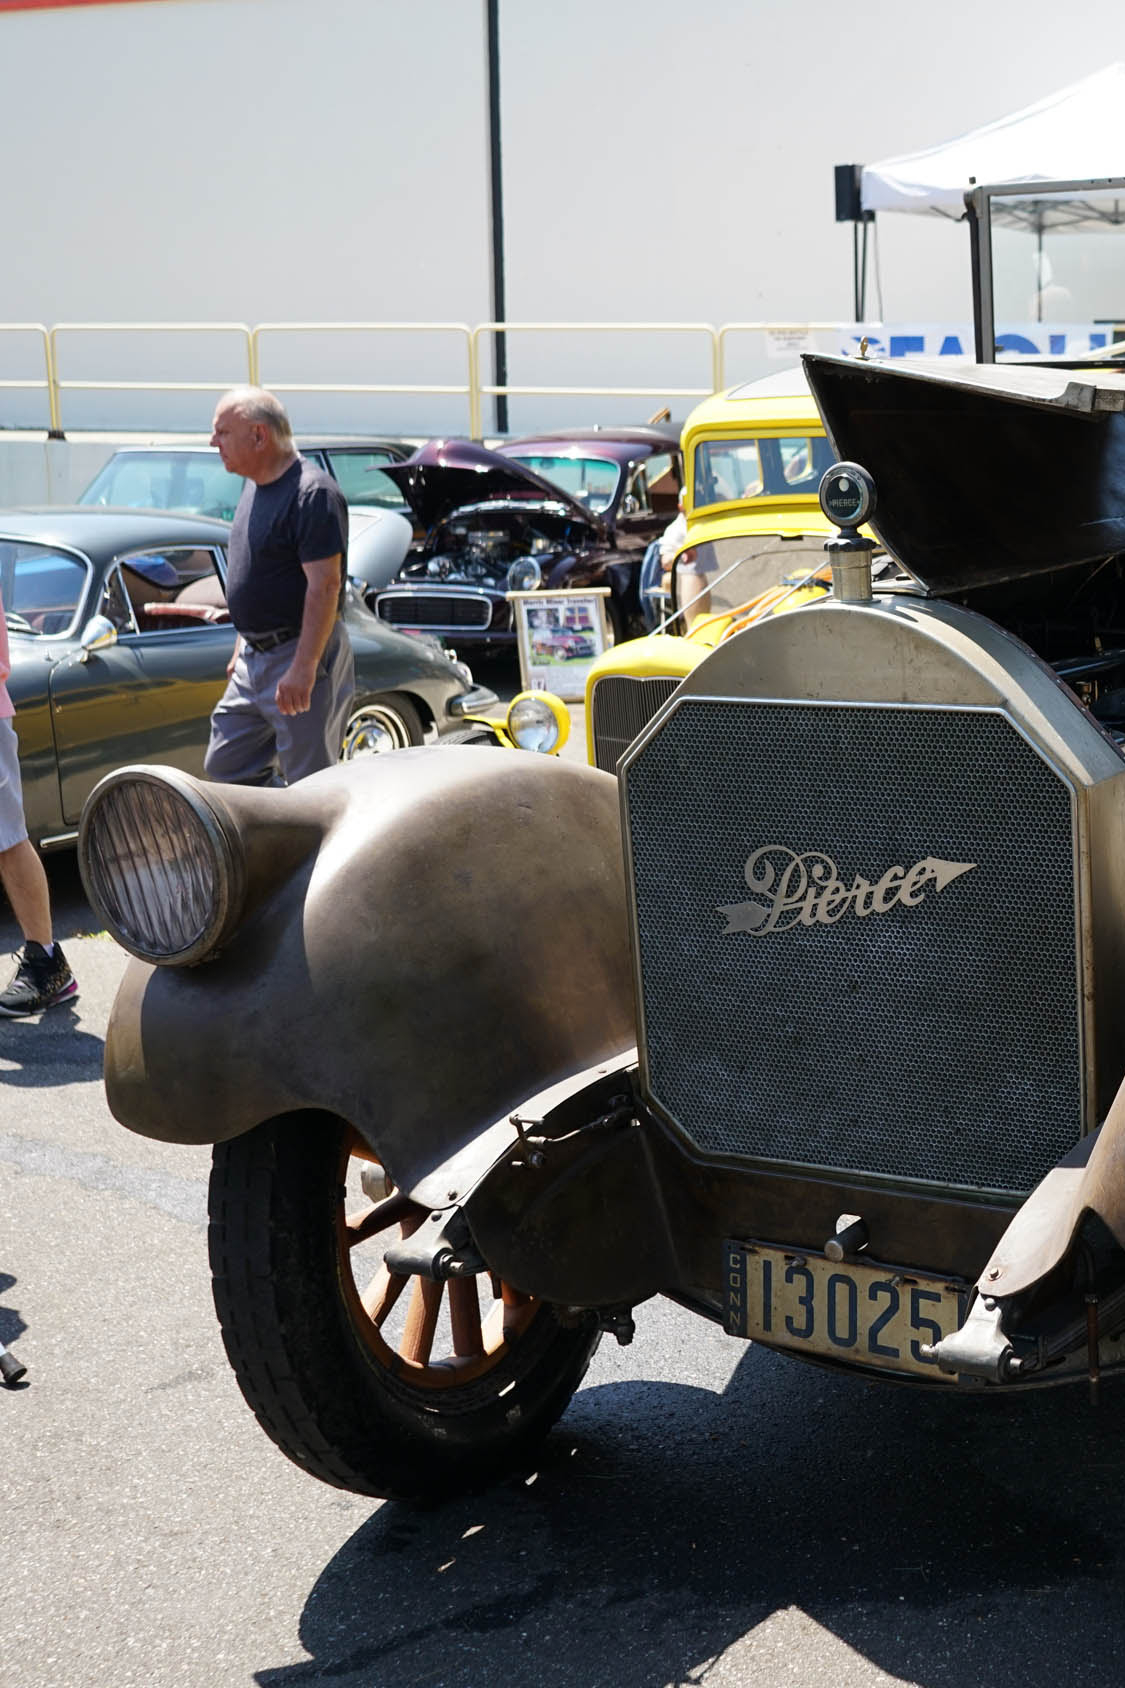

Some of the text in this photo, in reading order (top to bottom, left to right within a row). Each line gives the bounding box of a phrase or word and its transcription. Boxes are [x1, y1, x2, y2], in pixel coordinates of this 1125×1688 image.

[744, 845, 935, 936] Pierce
[728, 1253, 742, 1326] CONN
[762, 1259, 943, 1366] 13025
